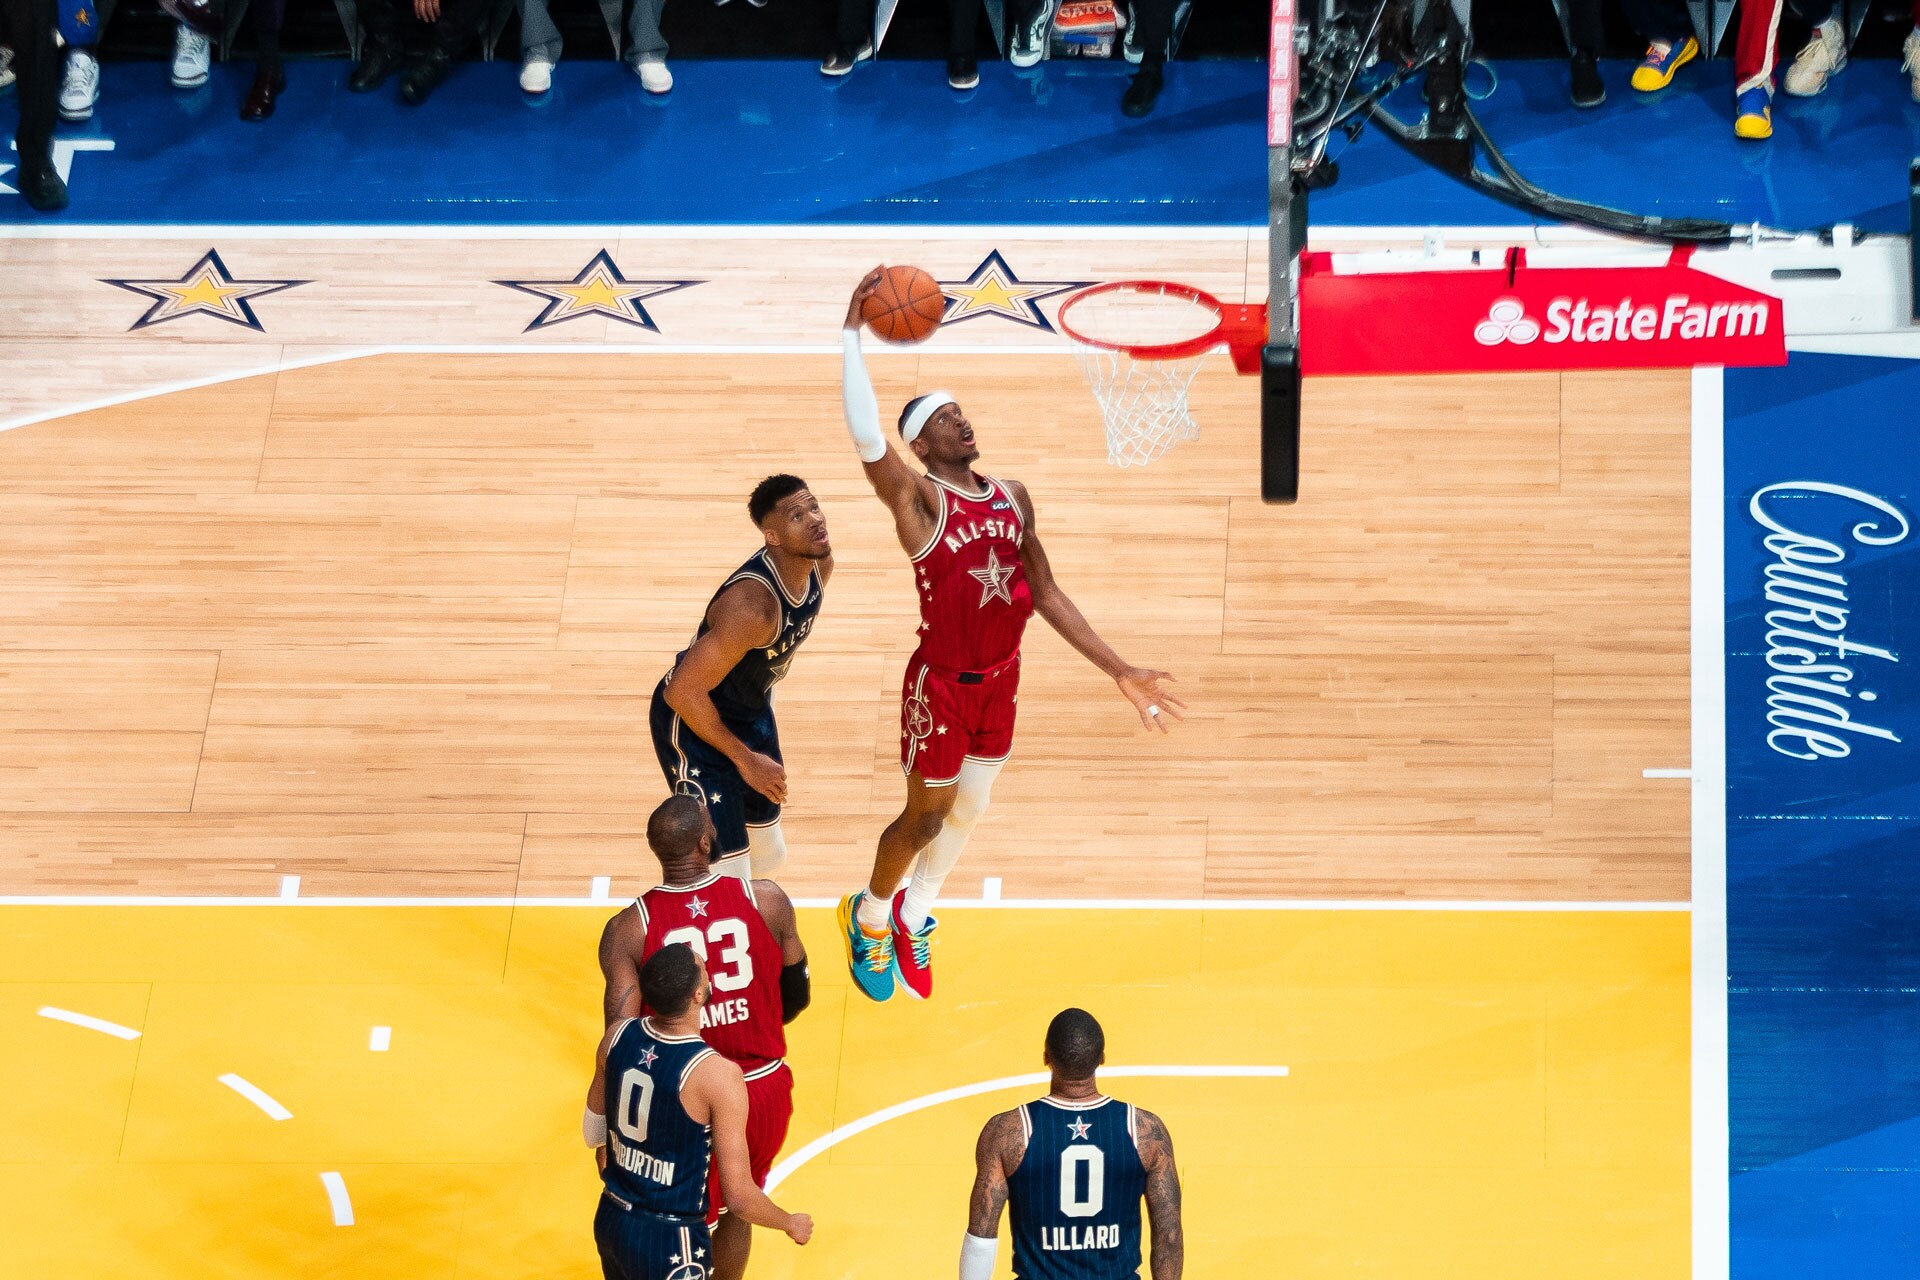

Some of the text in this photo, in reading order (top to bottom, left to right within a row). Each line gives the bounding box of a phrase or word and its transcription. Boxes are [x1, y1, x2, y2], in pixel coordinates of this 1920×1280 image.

[767, 616, 814, 660] ALL-ST
[1749, 481, 1909, 761] Courtside
[700, 998, 750, 1030] AMES
[618, 1067, 655, 1143] 0
[1060, 1144, 1105, 1218] 0
[1041, 1223, 1121, 1251] LILLARD
